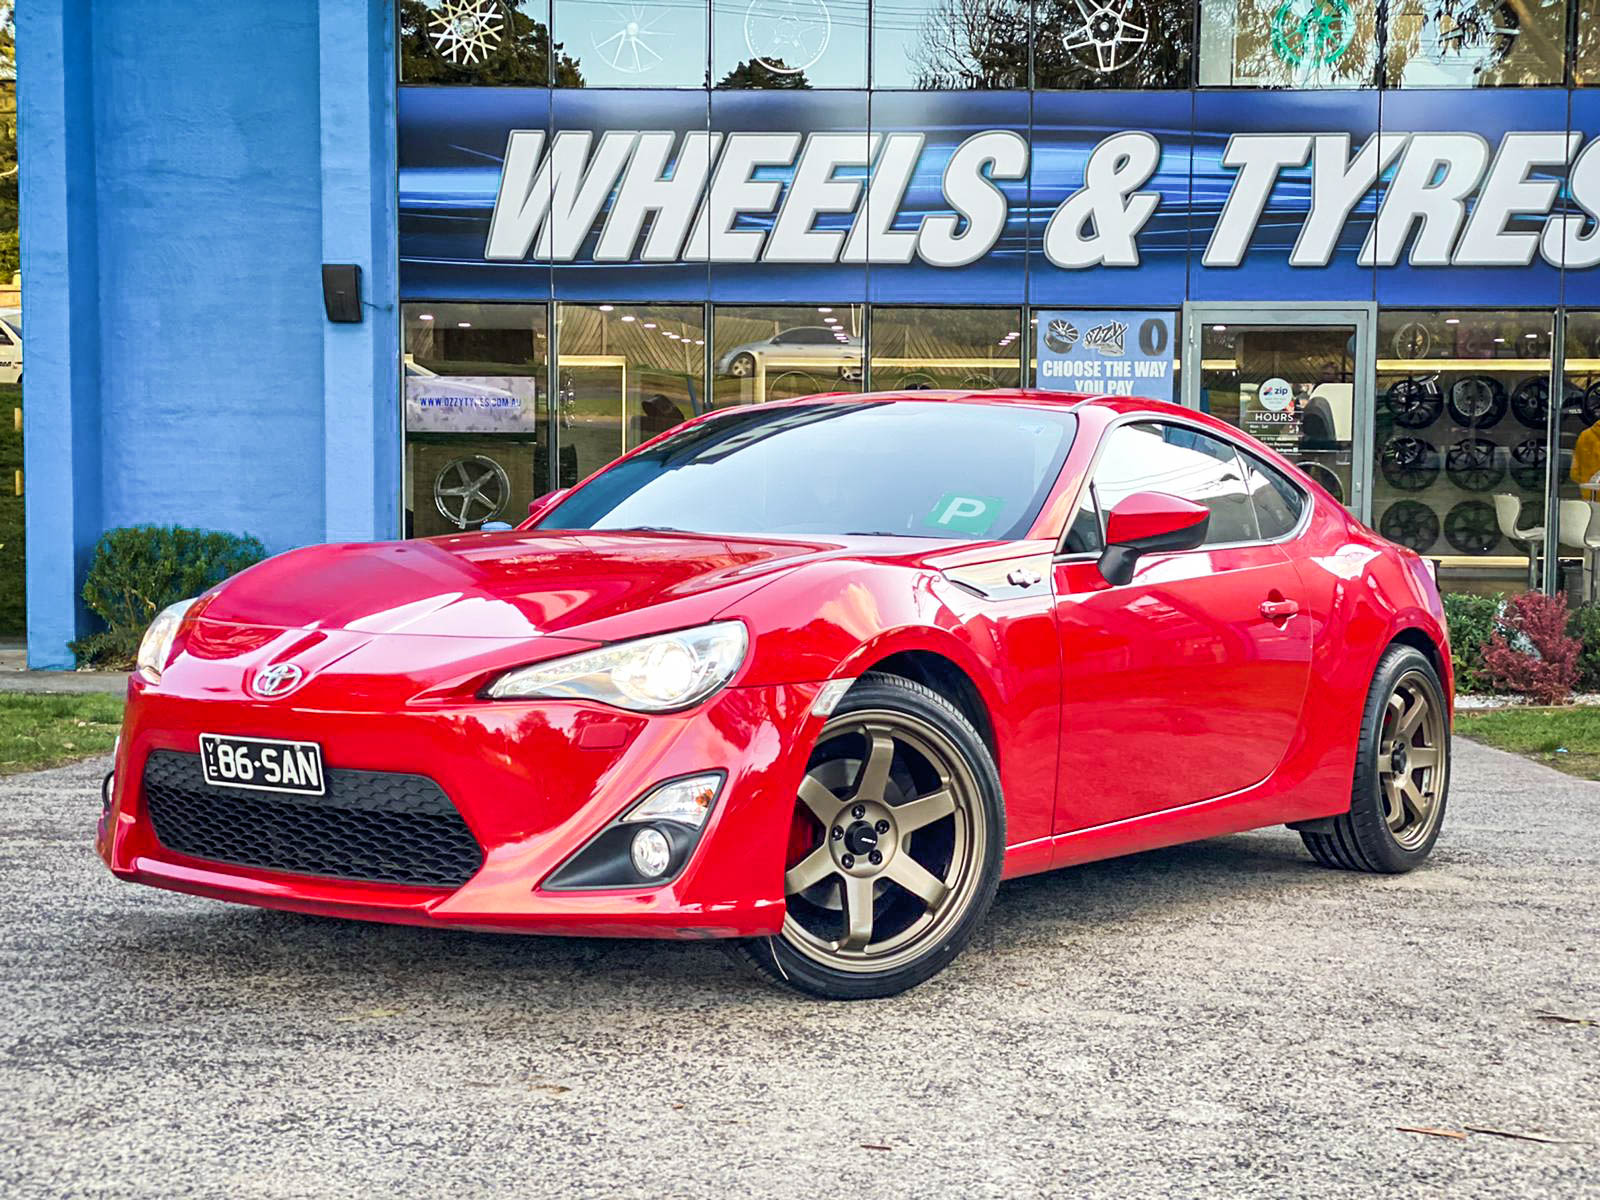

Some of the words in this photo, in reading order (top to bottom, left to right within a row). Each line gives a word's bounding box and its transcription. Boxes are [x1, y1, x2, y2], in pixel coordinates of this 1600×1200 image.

[484, 129, 1030, 268] WHEELS
[1043, 129, 1161, 269] &
[1042, 360, 1101, 377] CHOOSE
[1104, 360, 1131, 377] THE
[1133, 360, 1168, 377] WAY
[1075, 380, 1104, 393] YOU
[1107, 380, 1135, 395] PAY
[1274, 386, 1288, 396] zip
[1255, 413, 1294, 422] HOURS
[937, 496, 986, 525] P
